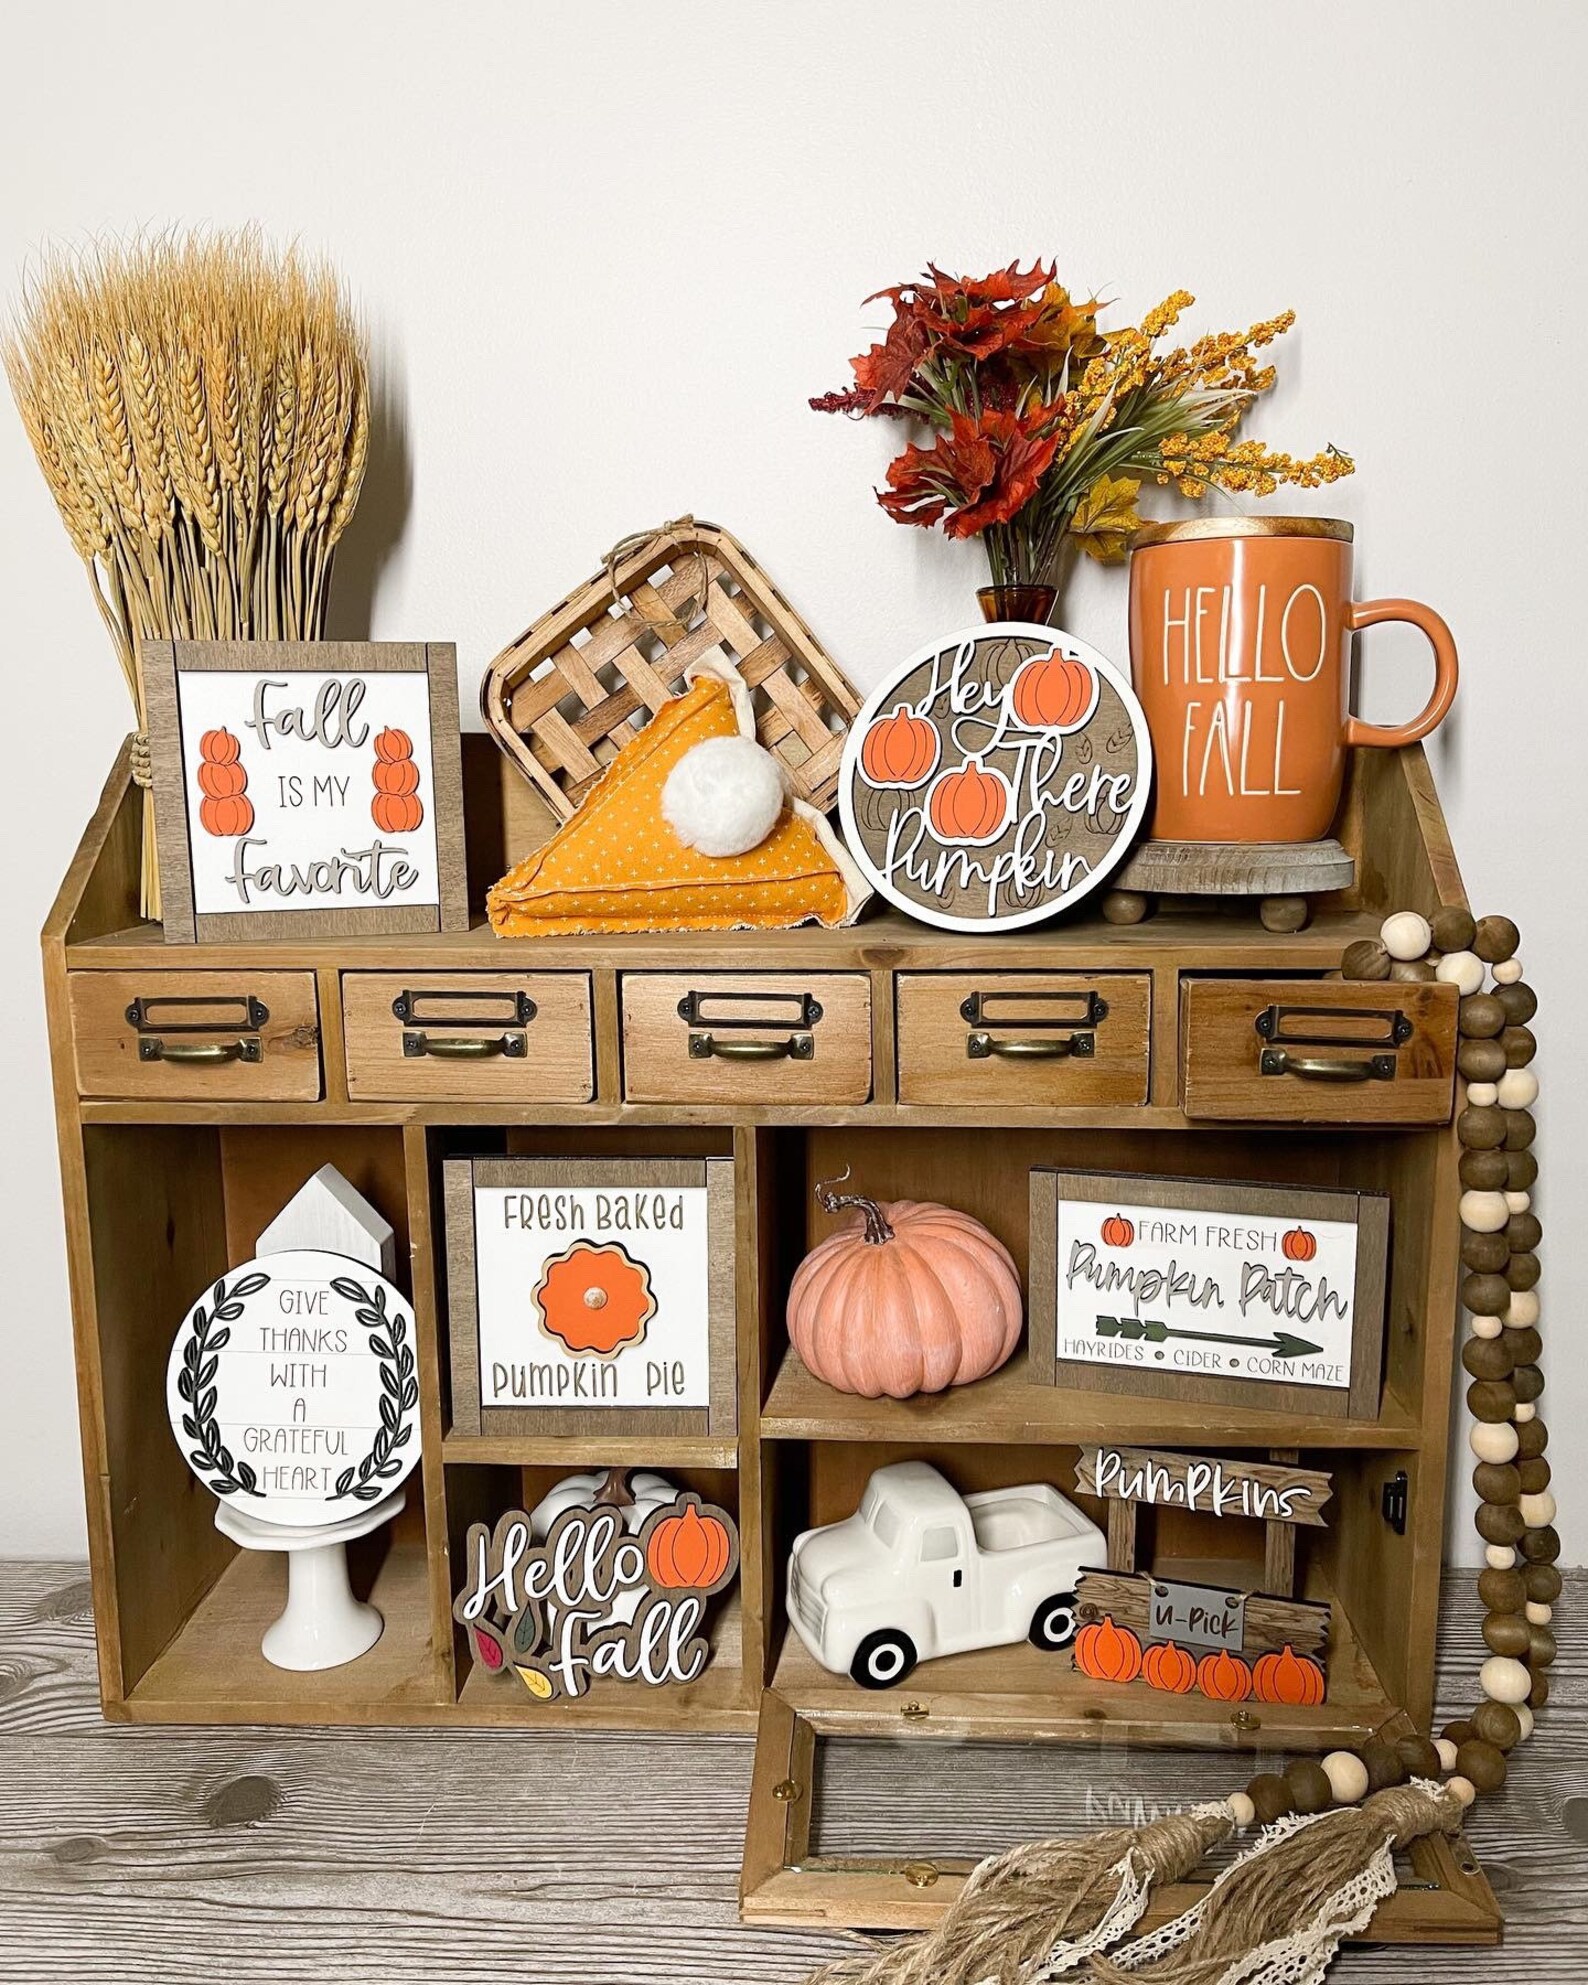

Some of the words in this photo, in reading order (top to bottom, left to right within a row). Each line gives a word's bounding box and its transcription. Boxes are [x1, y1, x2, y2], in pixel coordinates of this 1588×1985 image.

[1163, 583, 1326, 685] HELLO
[244, 678, 369, 750] Fall
[915, 638, 1018, 757] Hey
[1182, 700, 1301, 797] FALL
[277, 775, 302, 808] IS
[314, 775, 350, 808] MY
[996, 732, 1133, 824] There
[877, 807, 1093, 916] Pumpkin
[1138, 1220, 1197, 1246] FARM
[1206, 1226, 1278, 1252] FRESH
[279, 1289, 330, 1315] GIVE
[1066, 1239, 1224, 1317] Pumpkin
[1239, 1261, 1348, 1323] Patch
[259, 1327, 348, 1352] THANKS
[1064, 1338, 1144, 1361] HAYRIDES
[1173, 1349, 1222, 1369] CIDER
[1247, 1356, 1296, 1377] CORN
[1301, 1361, 1344, 1383] MAZE
[270, 1363, 327, 1388] WITH
[293, 1397, 306, 1423] A
[243, 1427, 349, 1455] GRATEFUL
[263, 1466, 332, 1491] HEART
[463, 1516, 644, 1619] Hello
[550, 1598, 702, 1697] Fall
